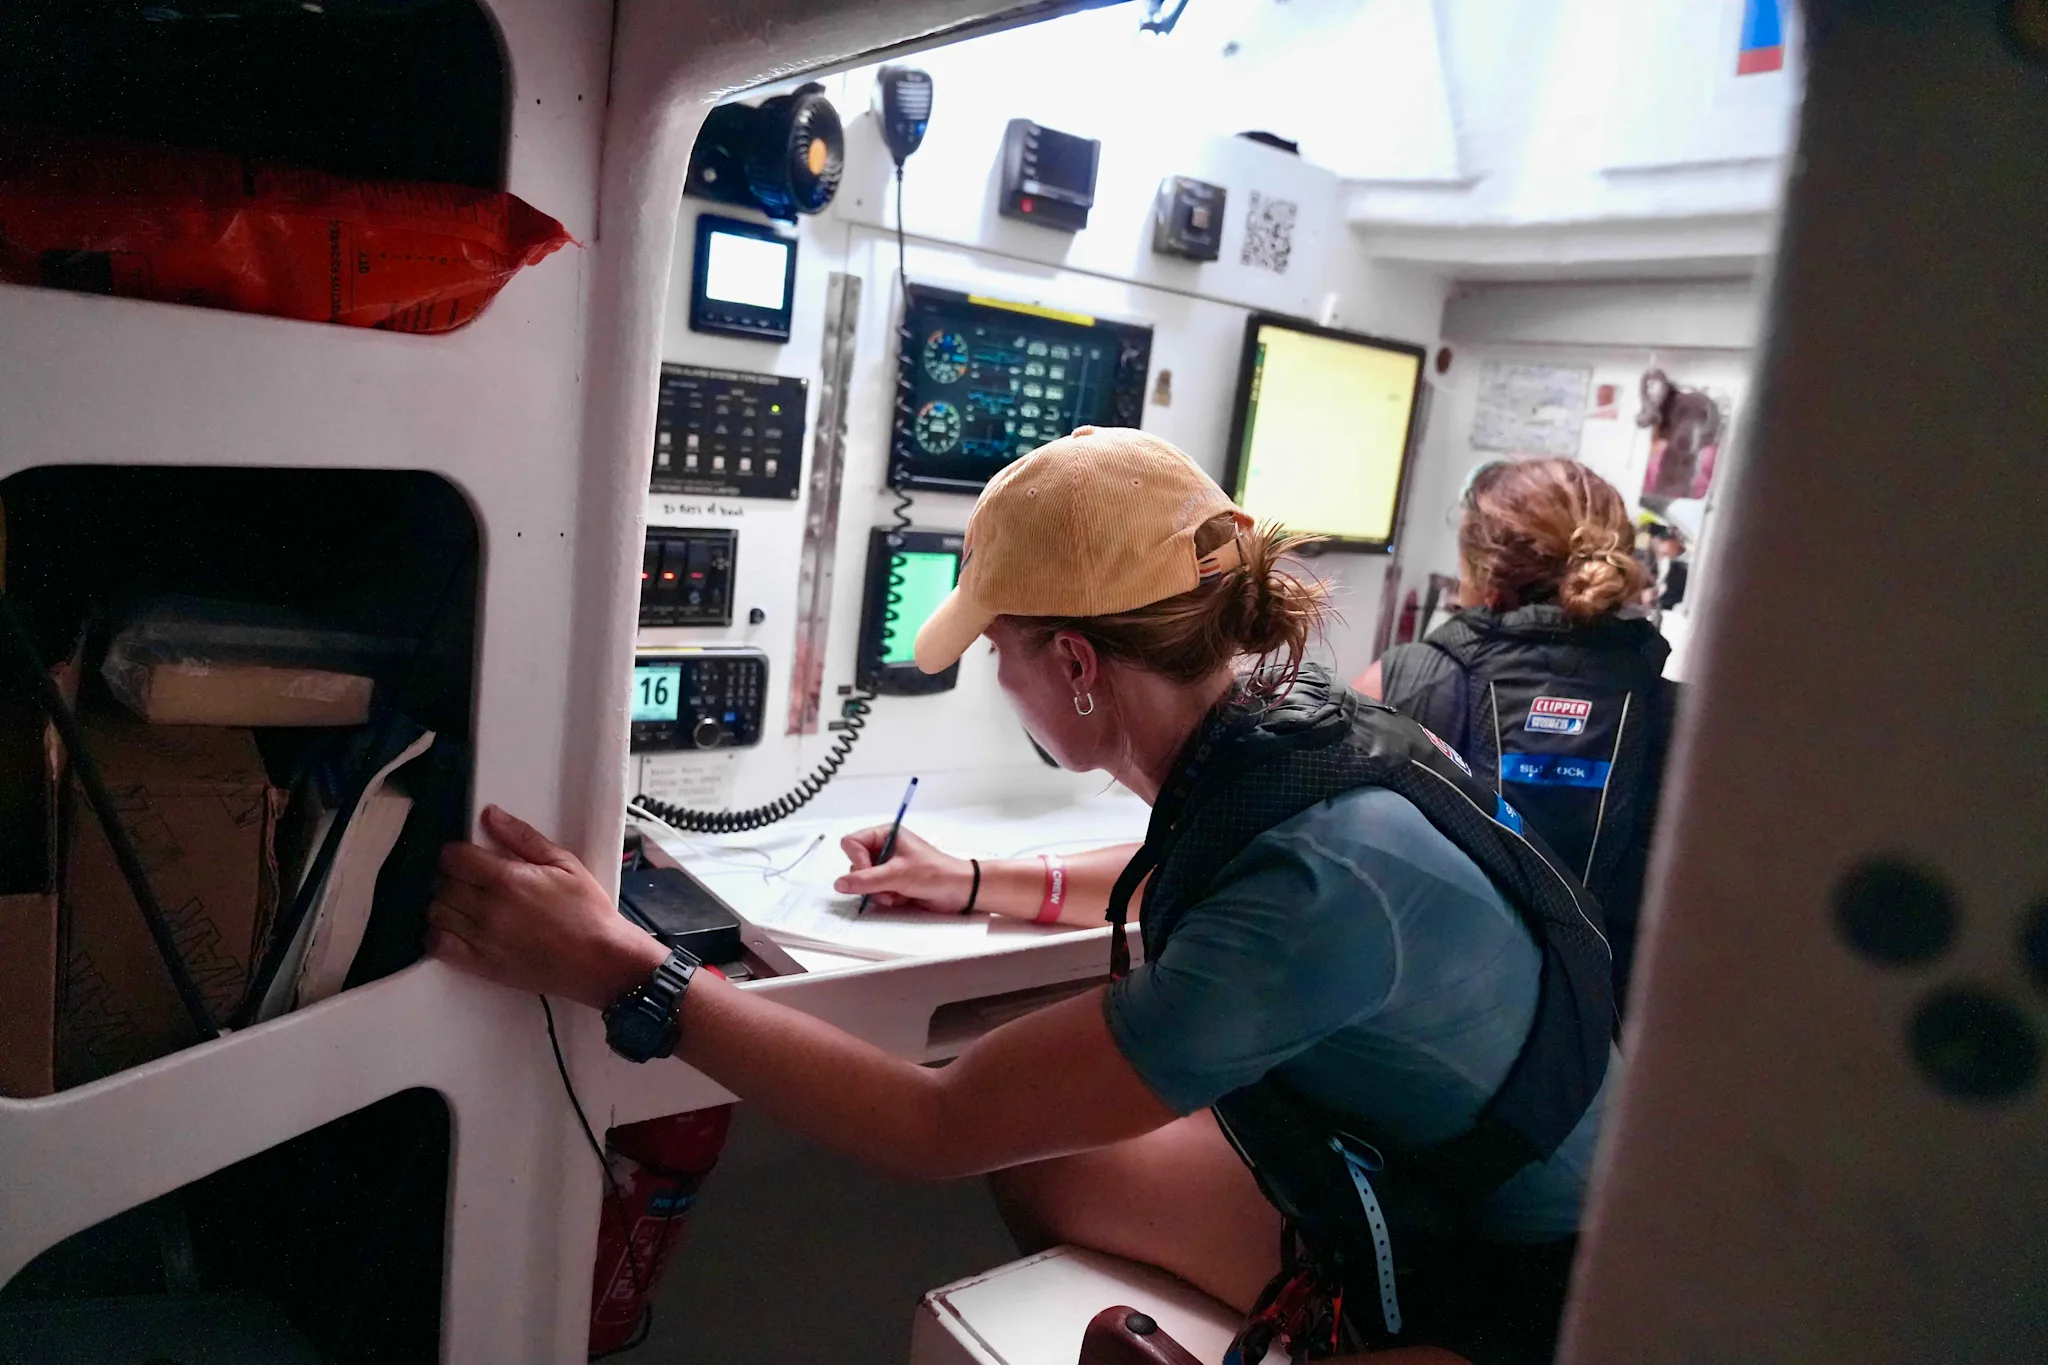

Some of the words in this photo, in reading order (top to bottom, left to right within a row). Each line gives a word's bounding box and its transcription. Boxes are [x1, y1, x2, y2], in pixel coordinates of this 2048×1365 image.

[359, 252, 370, 275] QTY
[640, 676, 669, 706] 16
[1536, 700, 1588, 715] CLIPPER
[1050, 870, 1063, 905] CREW
